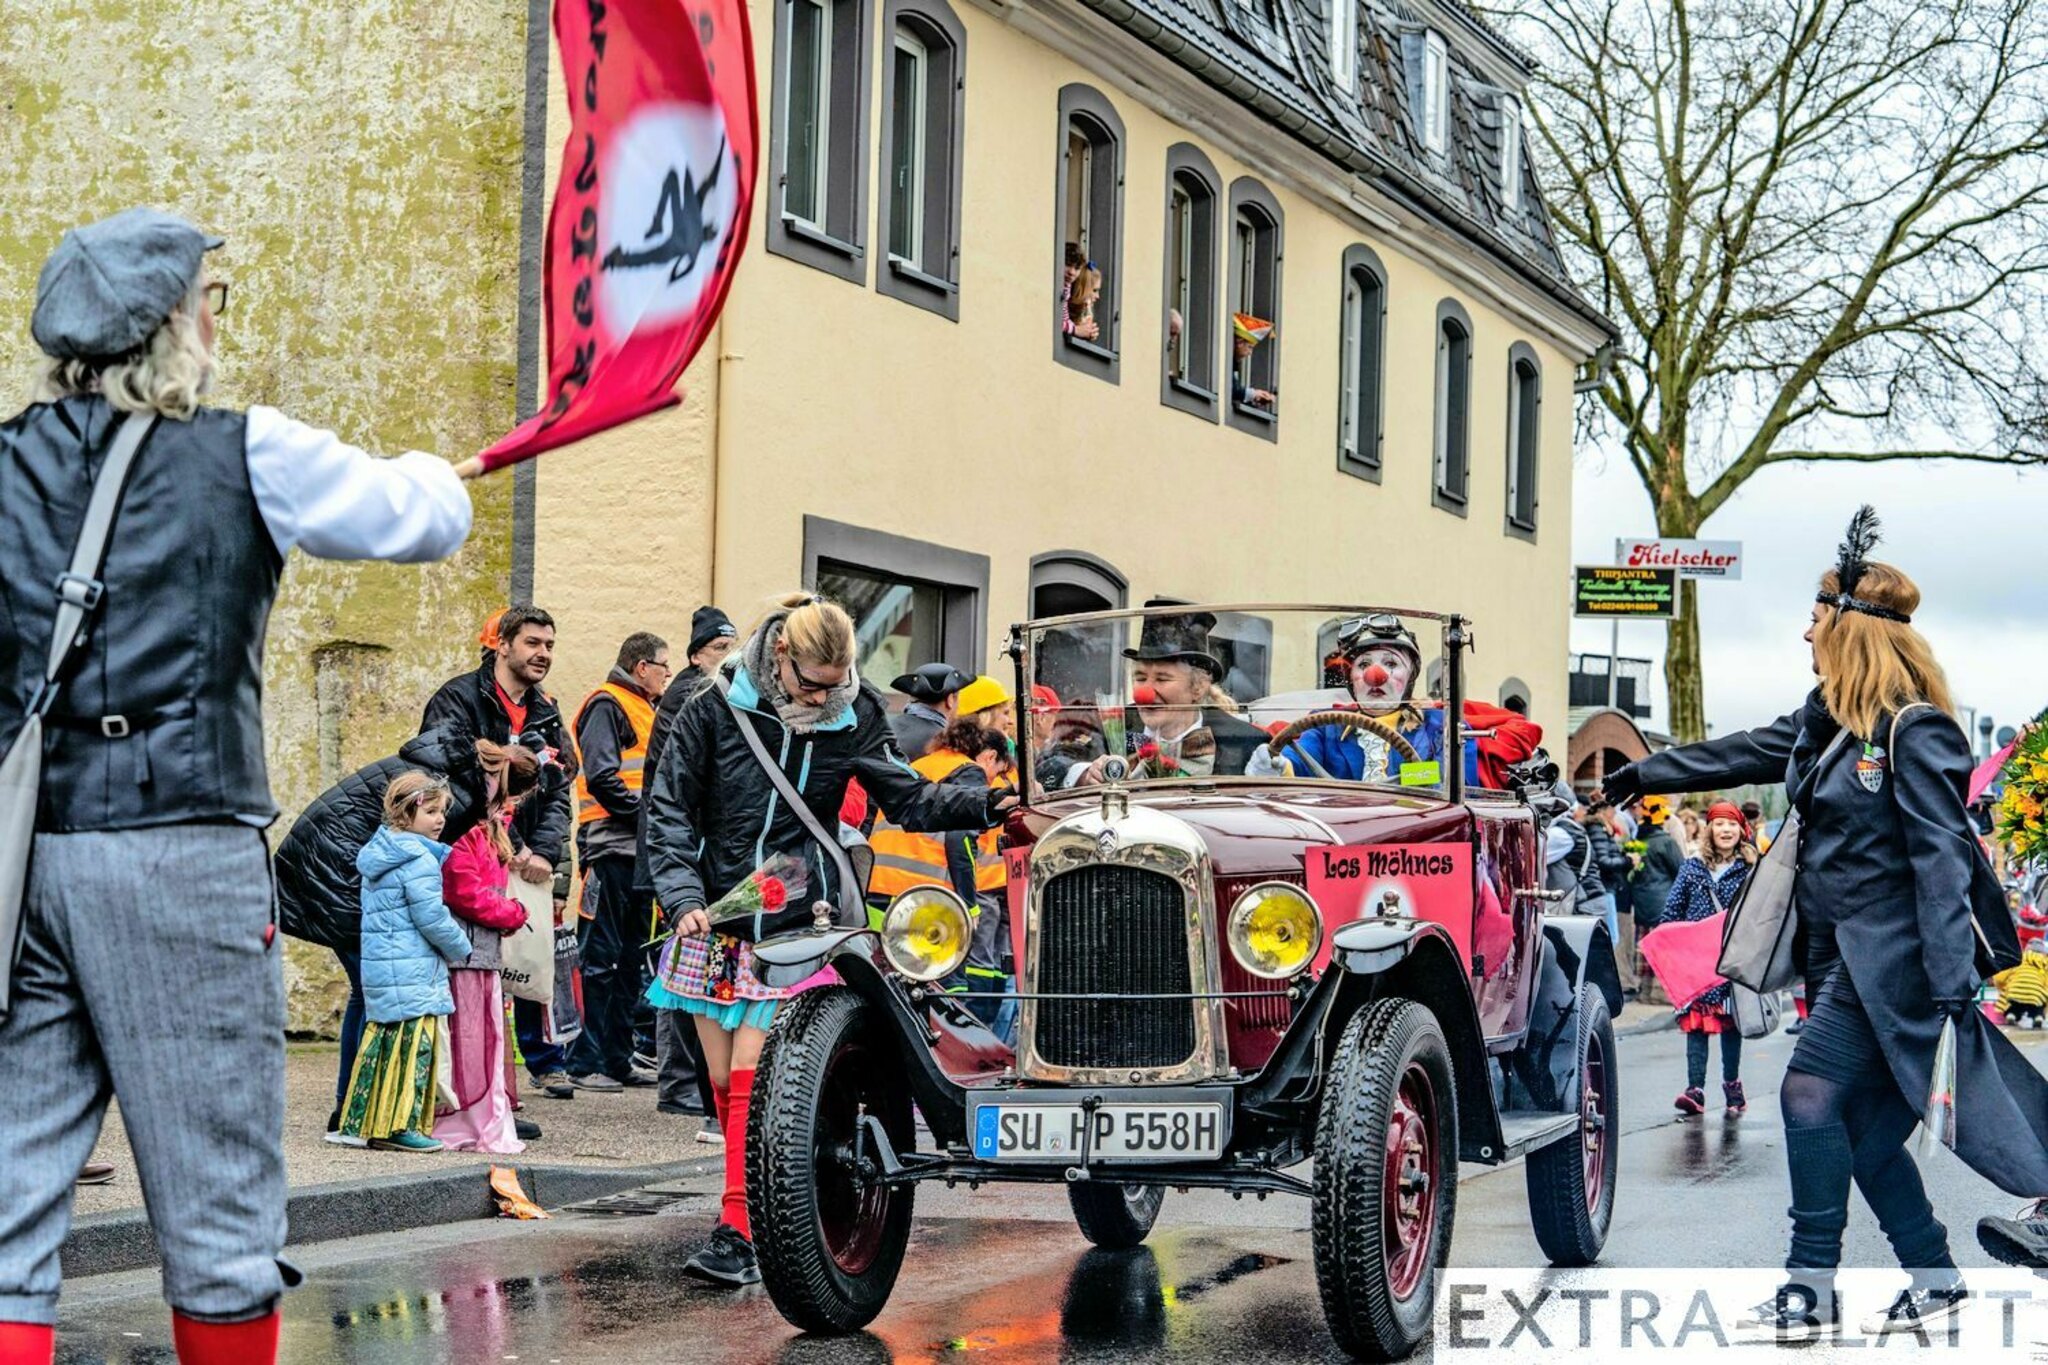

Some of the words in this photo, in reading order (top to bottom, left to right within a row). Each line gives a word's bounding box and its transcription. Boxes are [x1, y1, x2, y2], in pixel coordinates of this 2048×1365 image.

[1628, 543, 1737, 566] Hielscher
[1322, 852, 1360, 879] Los
[982, 1137, 992, 1149] D
[1000, 1112, 1042, 1151] SU
[1125, 1112, 1217, 1151] 558H
